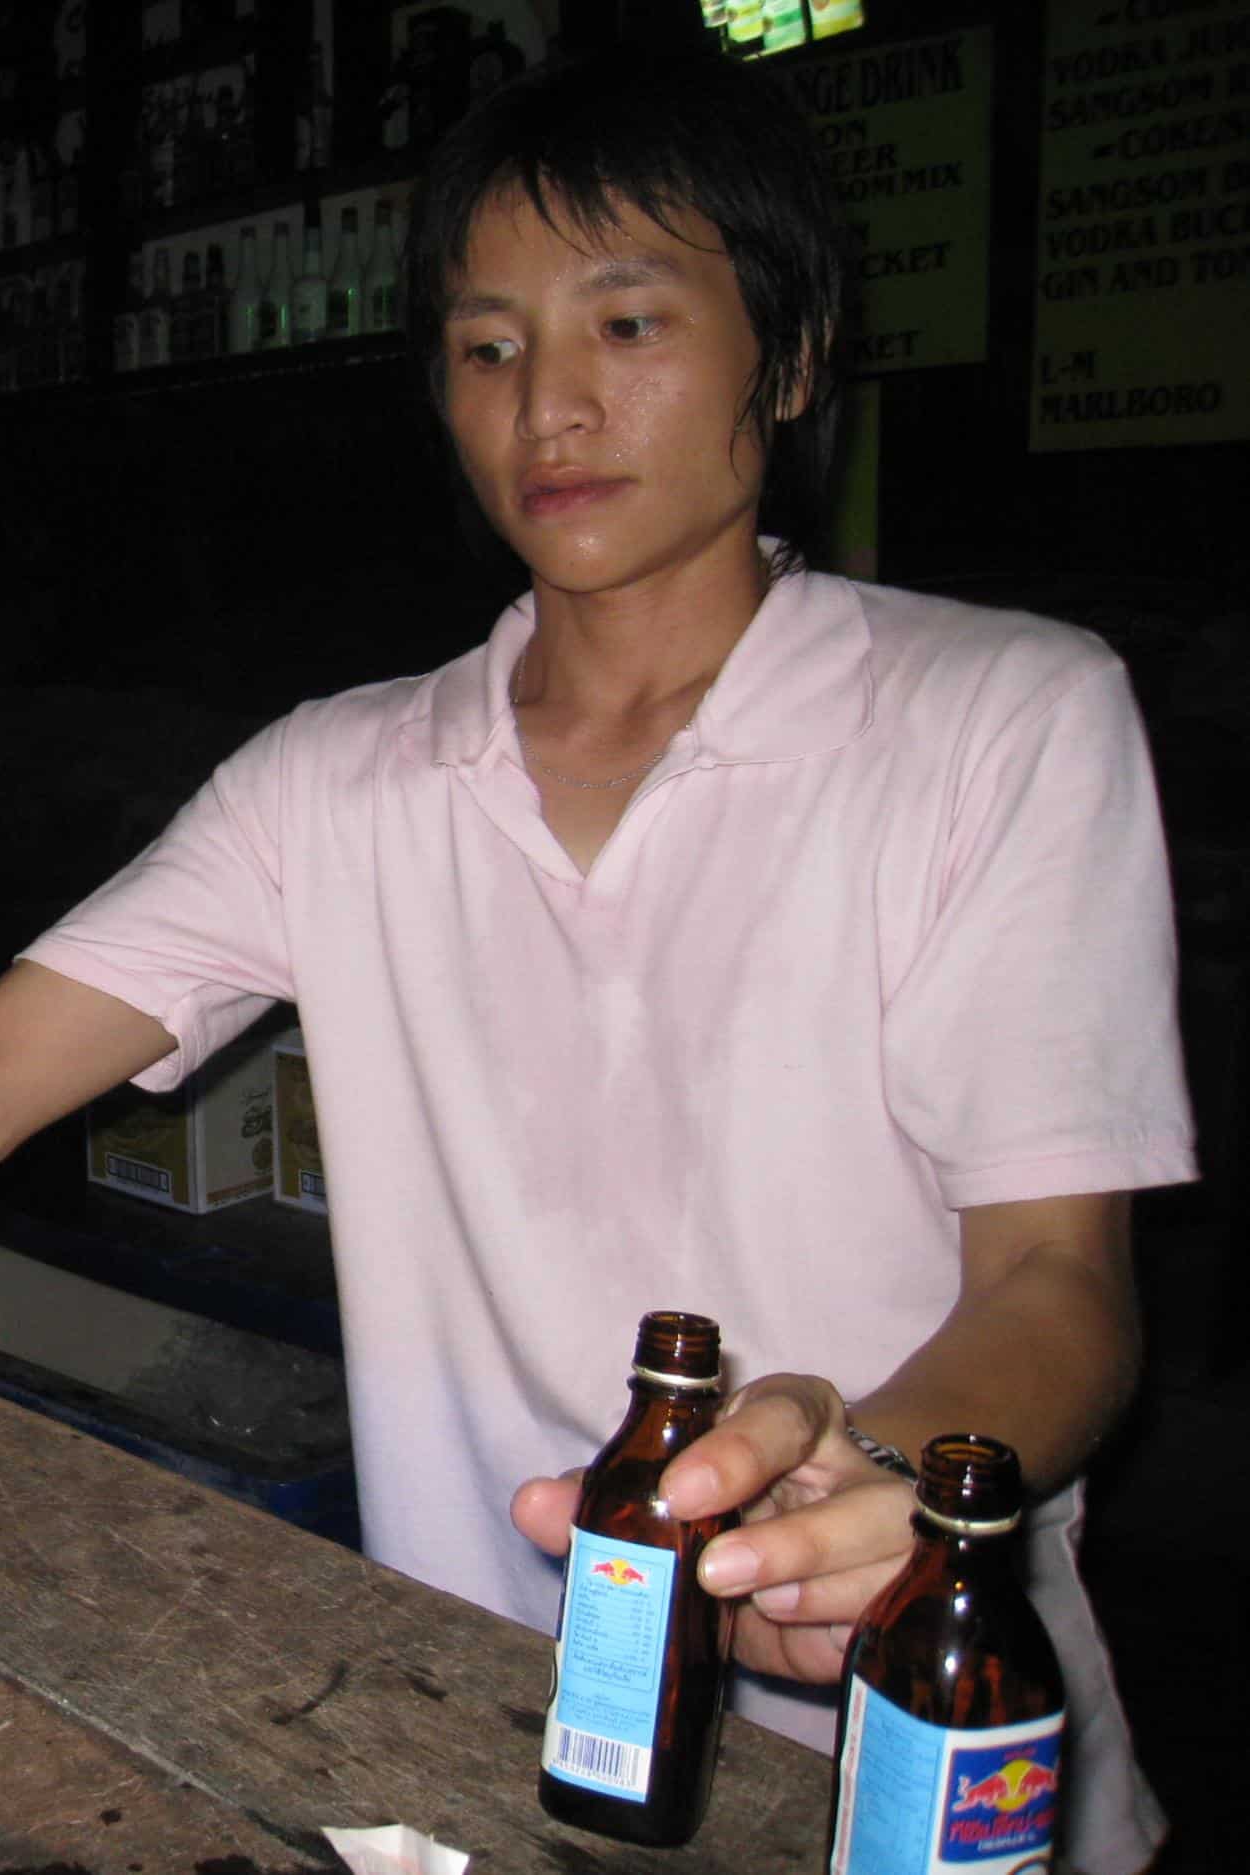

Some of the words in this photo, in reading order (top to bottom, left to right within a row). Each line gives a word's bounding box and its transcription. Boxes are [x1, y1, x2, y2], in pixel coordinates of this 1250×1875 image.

[861, 36, 967, 107] DRINK
[824, 144, 899, 175] EER
[1046, 167, 1207, 221] SANGSOM
[857, 241, 952, 280] CKET
[1039, 383, 1225, 424] MARLBORO
